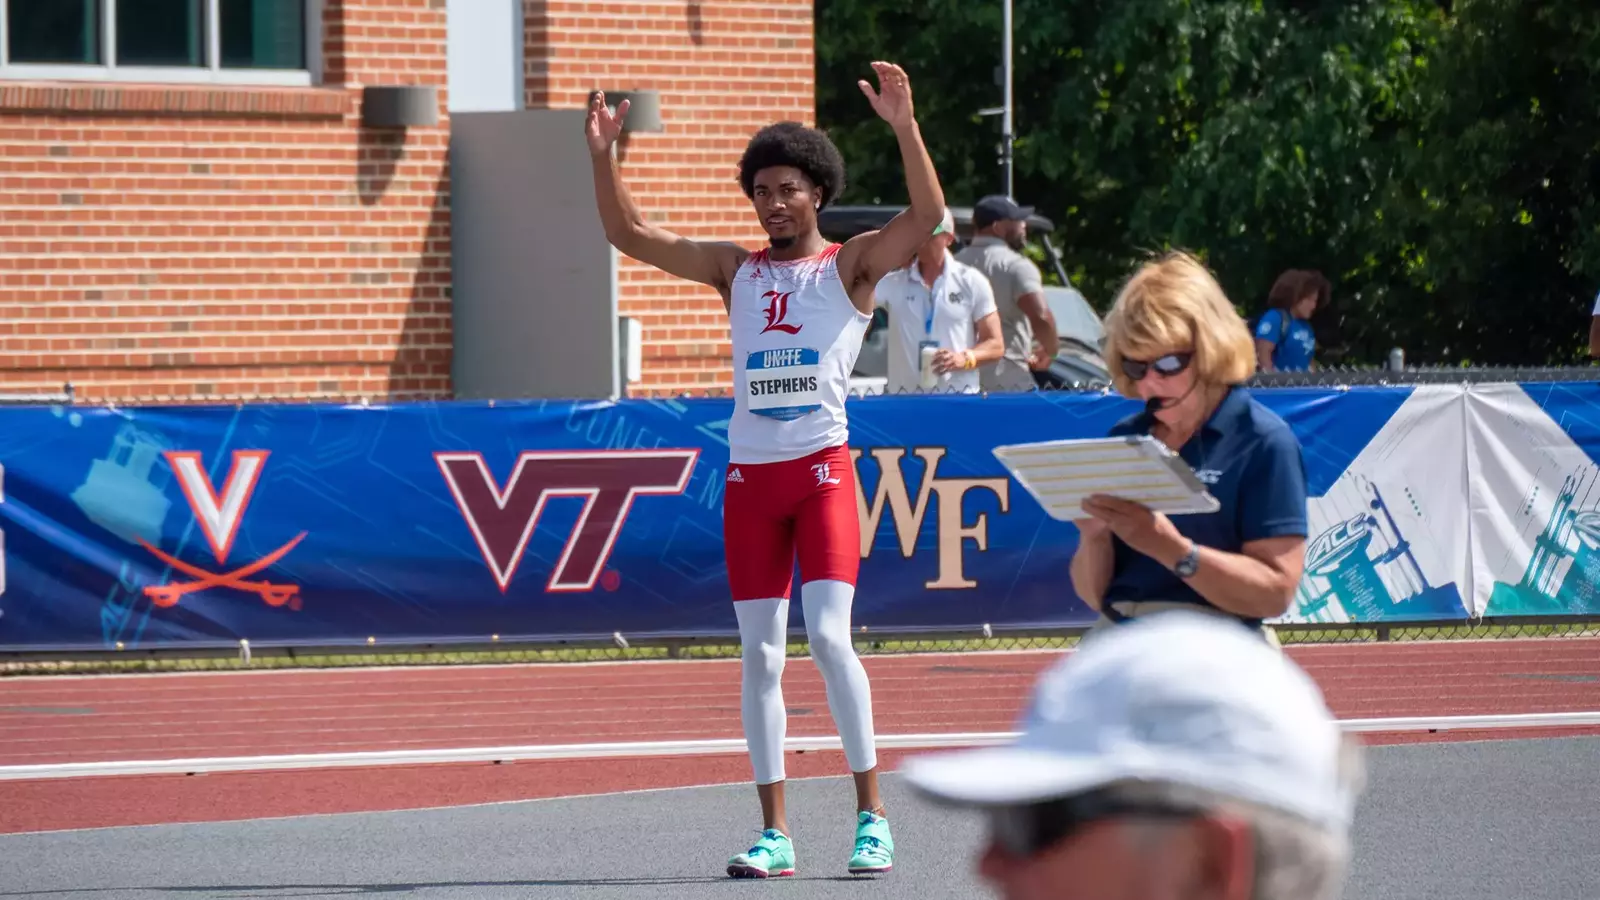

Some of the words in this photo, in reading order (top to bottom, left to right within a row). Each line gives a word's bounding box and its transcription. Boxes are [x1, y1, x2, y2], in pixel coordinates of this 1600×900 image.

[760, 290, 803, 335] L
[763, 348, 803, 368] UNITE
[750, 376, 818, 396] STEPHENS
[810, 461, 841, 488] L
[164, 450, 271, 565] V
[432, 448, 701, 593] VT
[849, 446, 1009, 590] WF
[1309, 512, 1367, 565] ACC
